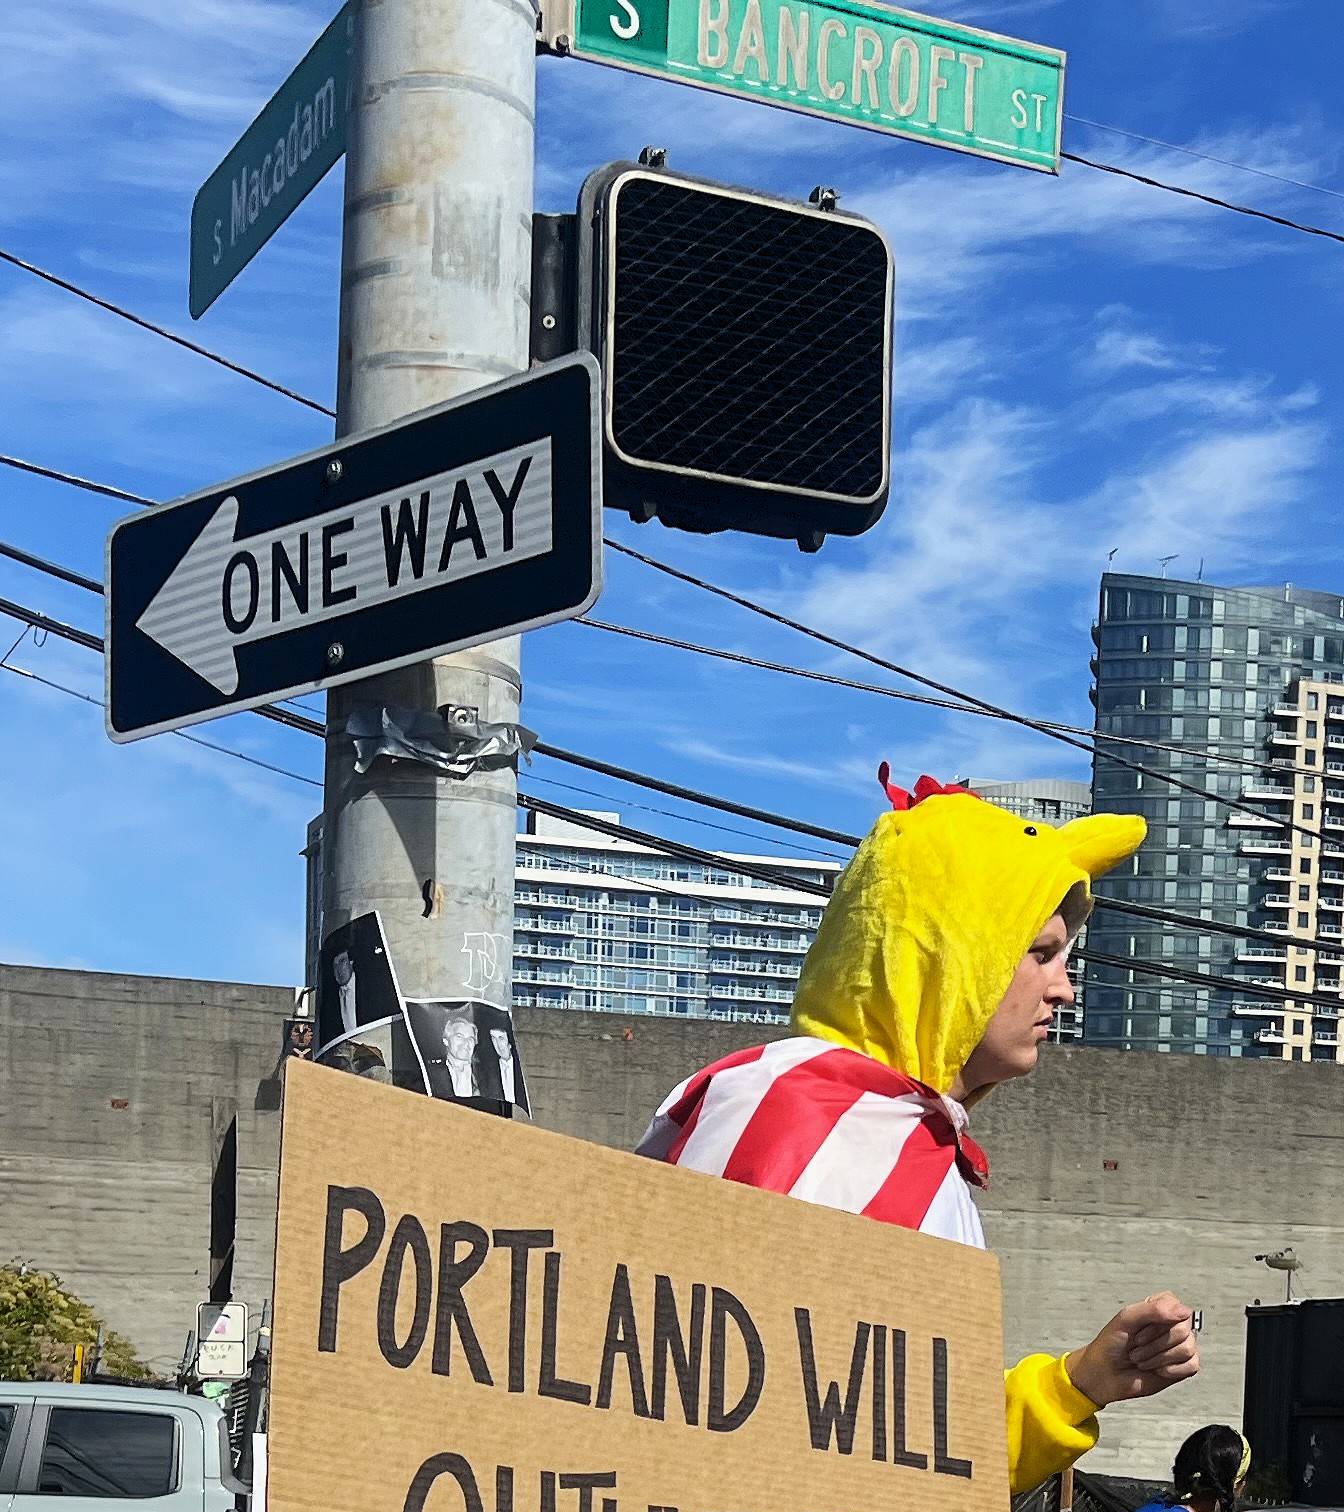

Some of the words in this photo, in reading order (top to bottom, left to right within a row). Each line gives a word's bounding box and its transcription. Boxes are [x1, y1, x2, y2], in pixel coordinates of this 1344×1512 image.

[697, 0, 984, 133] BANCROFT
[1010, 88, 1048, 133] ST
[213, 219, 223, 267] S
[230, 76, 336, 247] Macadam
[222, 517, 358, 635] ONE
[380, 456, 533, 588] WAY
[318, 1184, 766, 1433] PORTLAND
[794, 1306, 973, 1480] WILL
